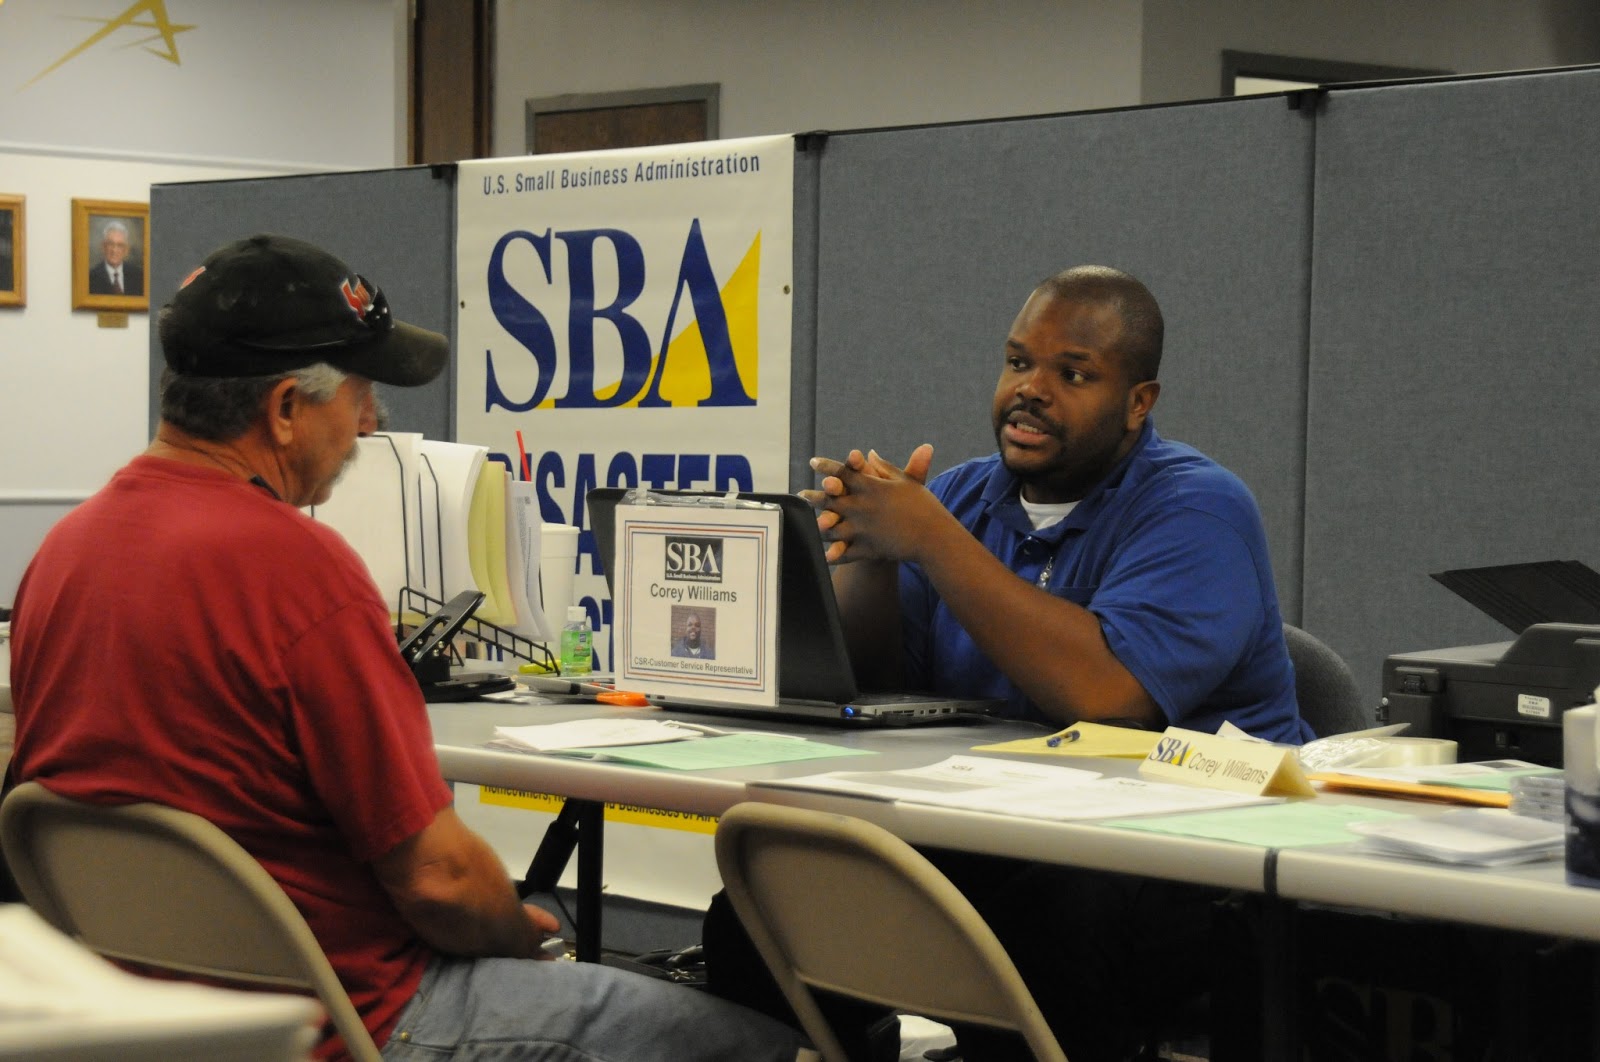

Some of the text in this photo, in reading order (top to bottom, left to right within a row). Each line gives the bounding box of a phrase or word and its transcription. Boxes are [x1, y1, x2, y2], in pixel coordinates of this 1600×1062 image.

[483, 153, 760, 195] U.S. Small Business Administration
[486, 217, 758, 413] SBA
[666, 542, 721, 574] SBA
[650, 583, 738, 603] Corey Williams
[634, 656, 754, 675] CSR-Customer Service Representative
[1149, 737, 1192, 767] SBA
[1188, 752, 1268, 784] Corey Williams
